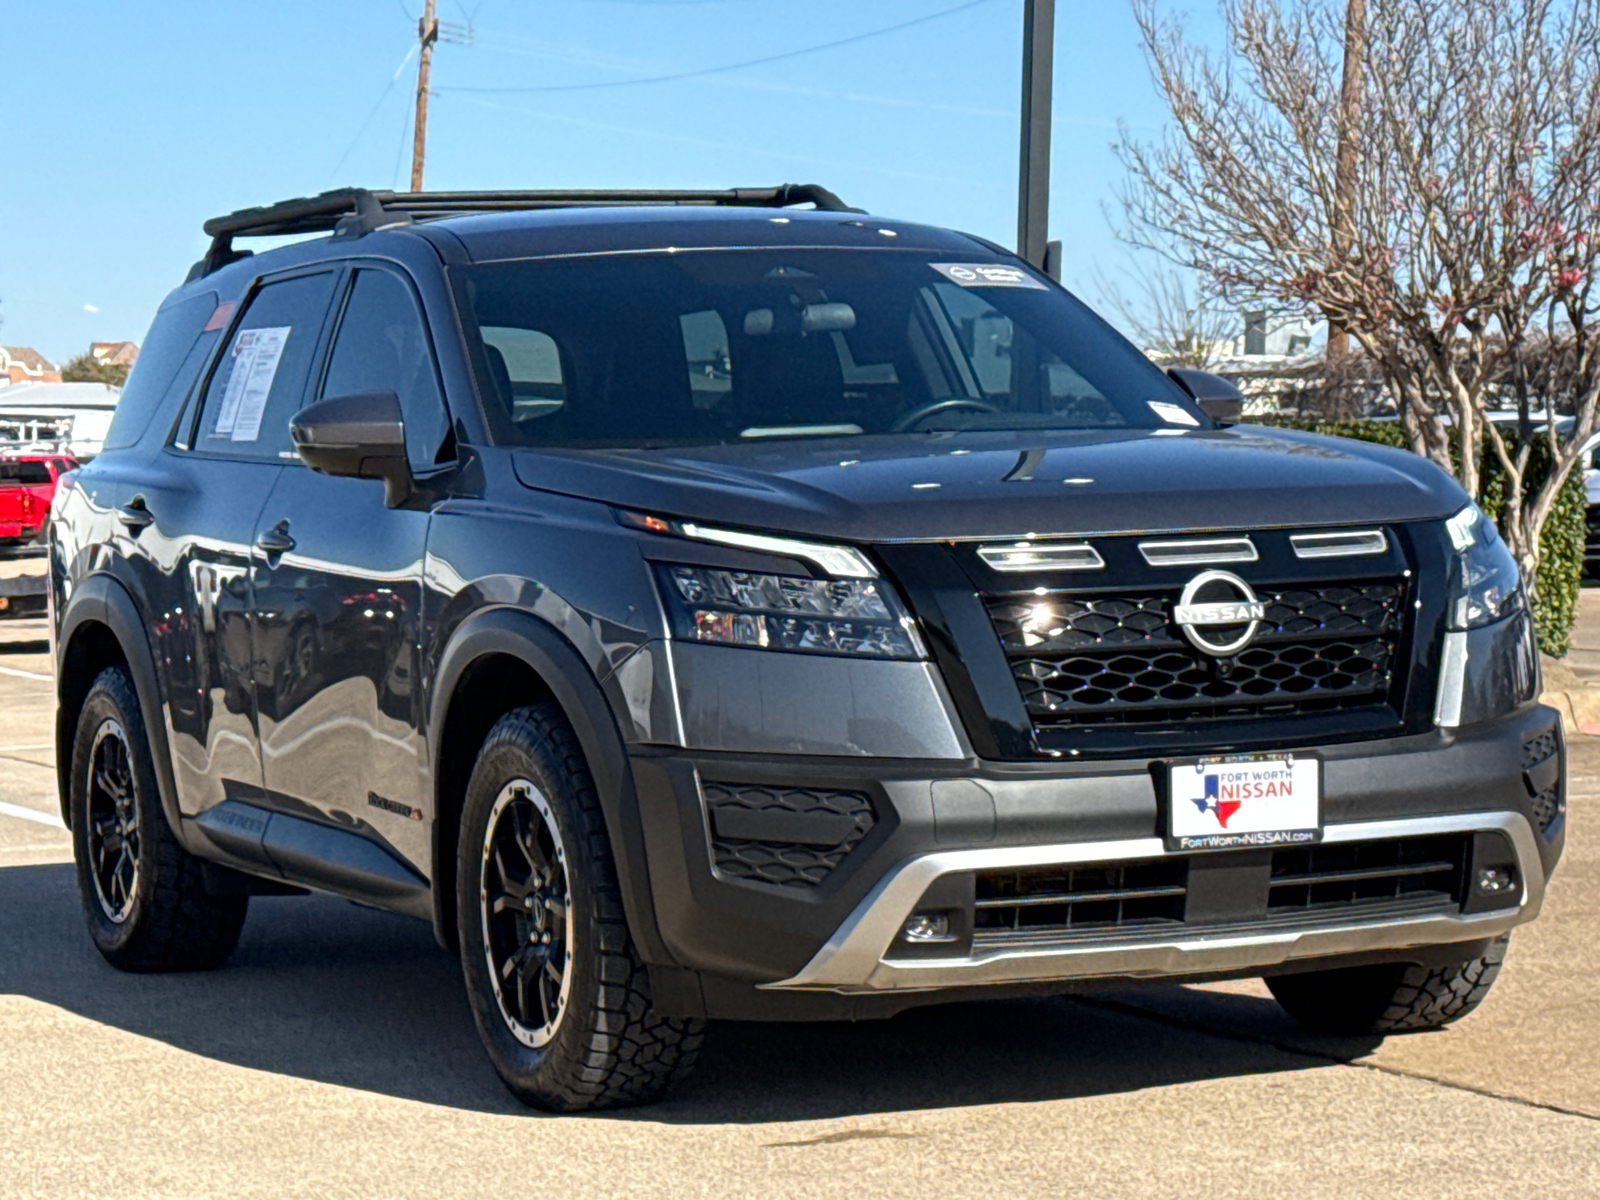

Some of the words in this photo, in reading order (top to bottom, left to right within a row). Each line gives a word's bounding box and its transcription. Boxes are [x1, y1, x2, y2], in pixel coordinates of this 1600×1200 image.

[1179, 605, 1264, 622] NISSAN
[1220, 772, 1249, 782] FORT
[1252, 770, 1293, 781] WORTH
[1220, 780, 1293, 800] NISSAN
